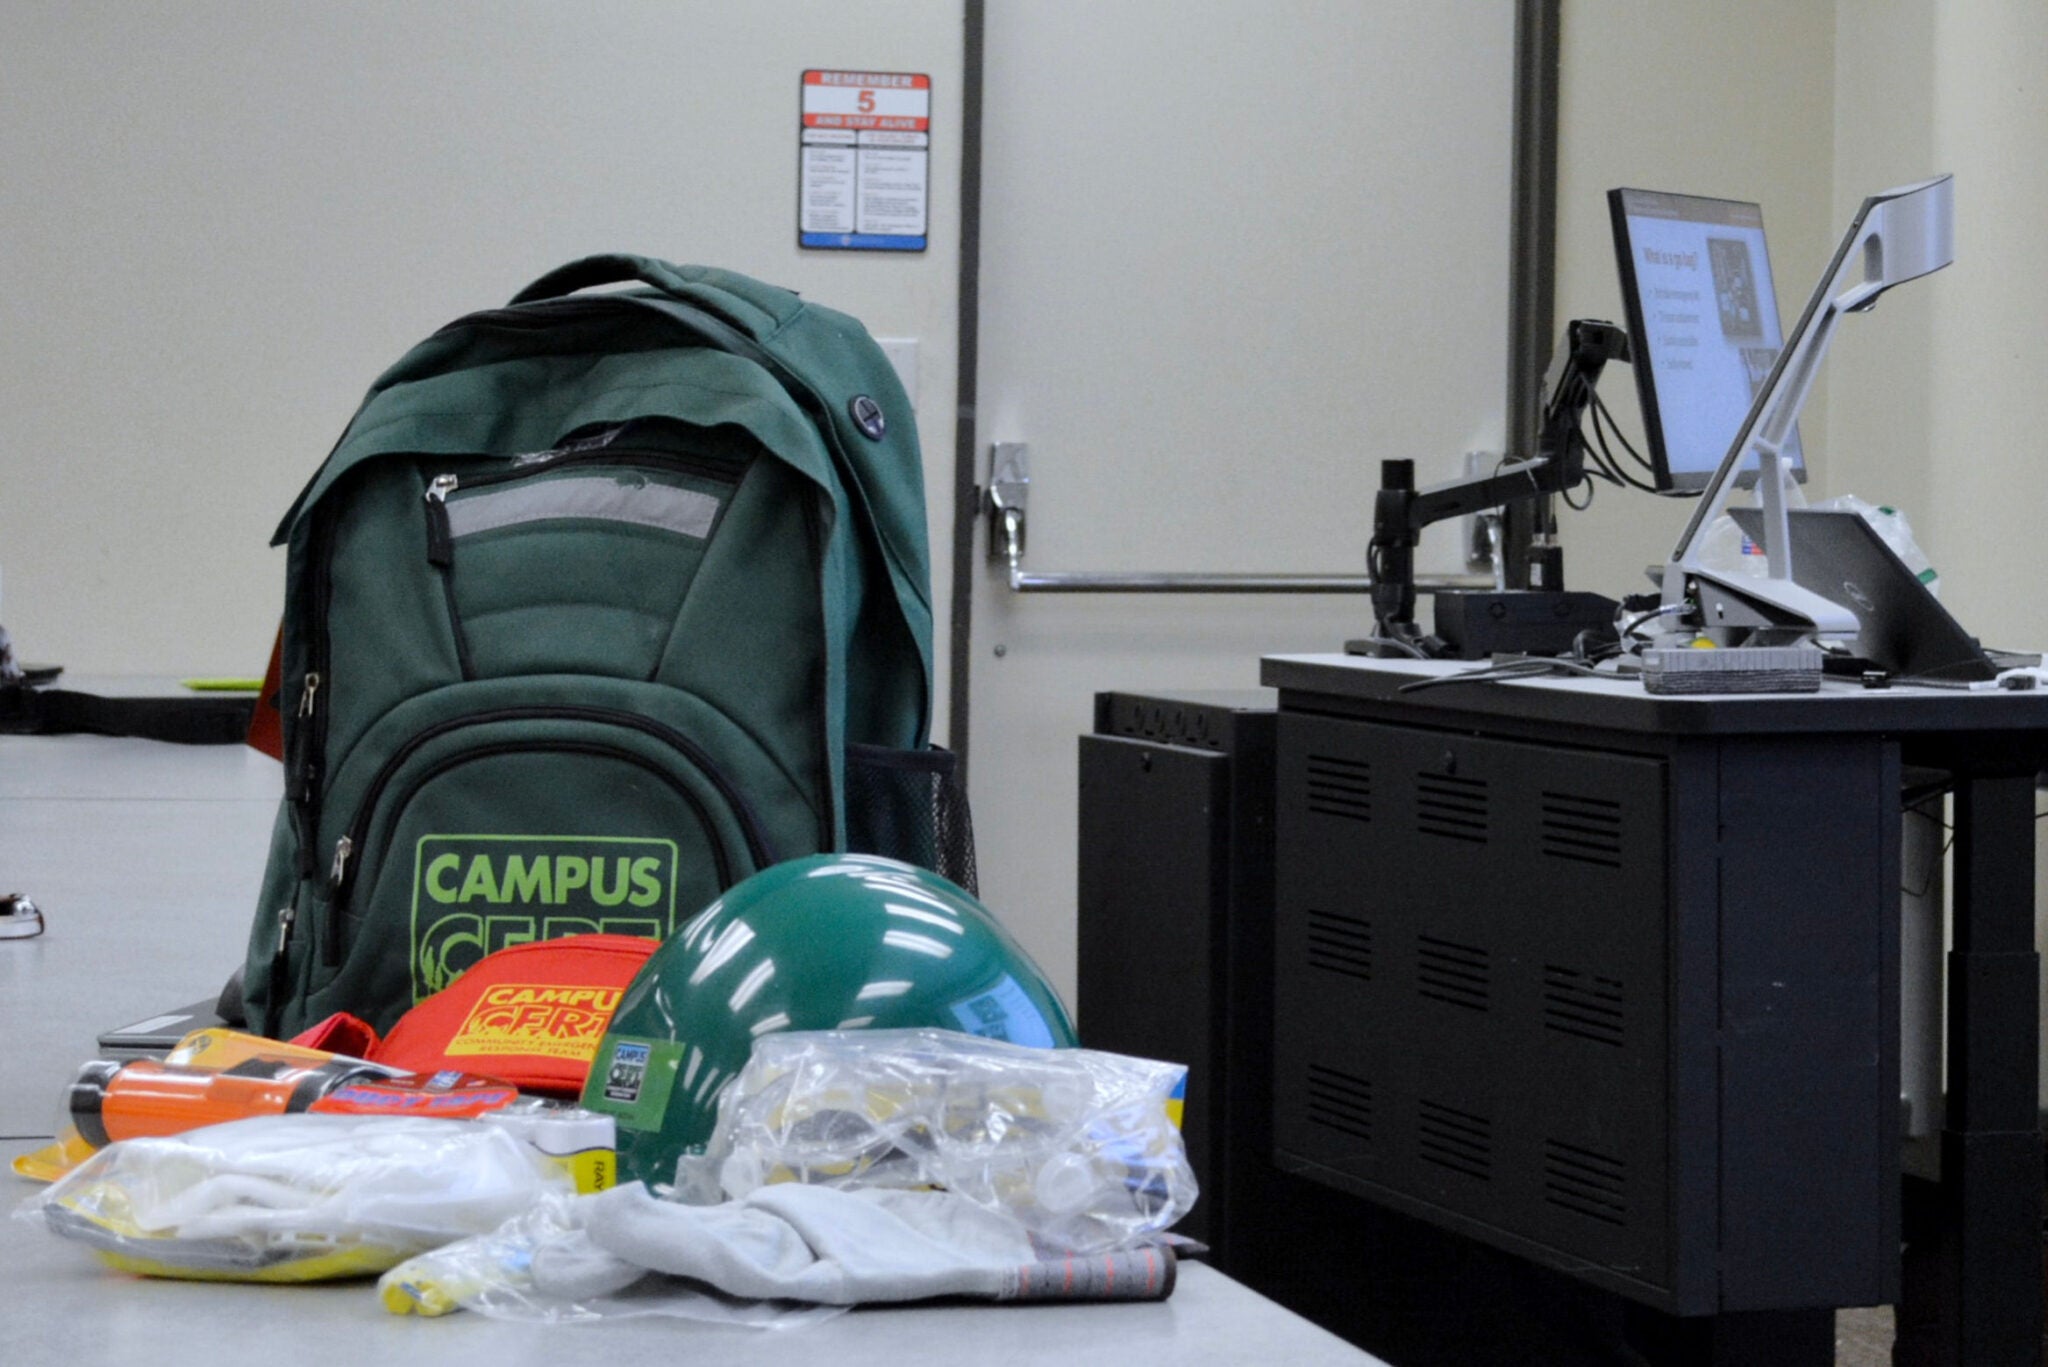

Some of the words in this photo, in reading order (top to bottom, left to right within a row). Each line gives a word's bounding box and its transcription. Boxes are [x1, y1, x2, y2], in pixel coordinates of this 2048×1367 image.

[821, 72, 913, 88] REMEMBER
[857, 90, 876, 113] 5
[815, 115, 842, 126] AND
[845, 116, 877, 127] STAY
[880, 117, 917, 128] ALIVE
[425, 853, 661, 907] CAMPUS
[487, 988, 623, 1011] CAMPU
[615, 1046, 648, 1063] CAMPUS
